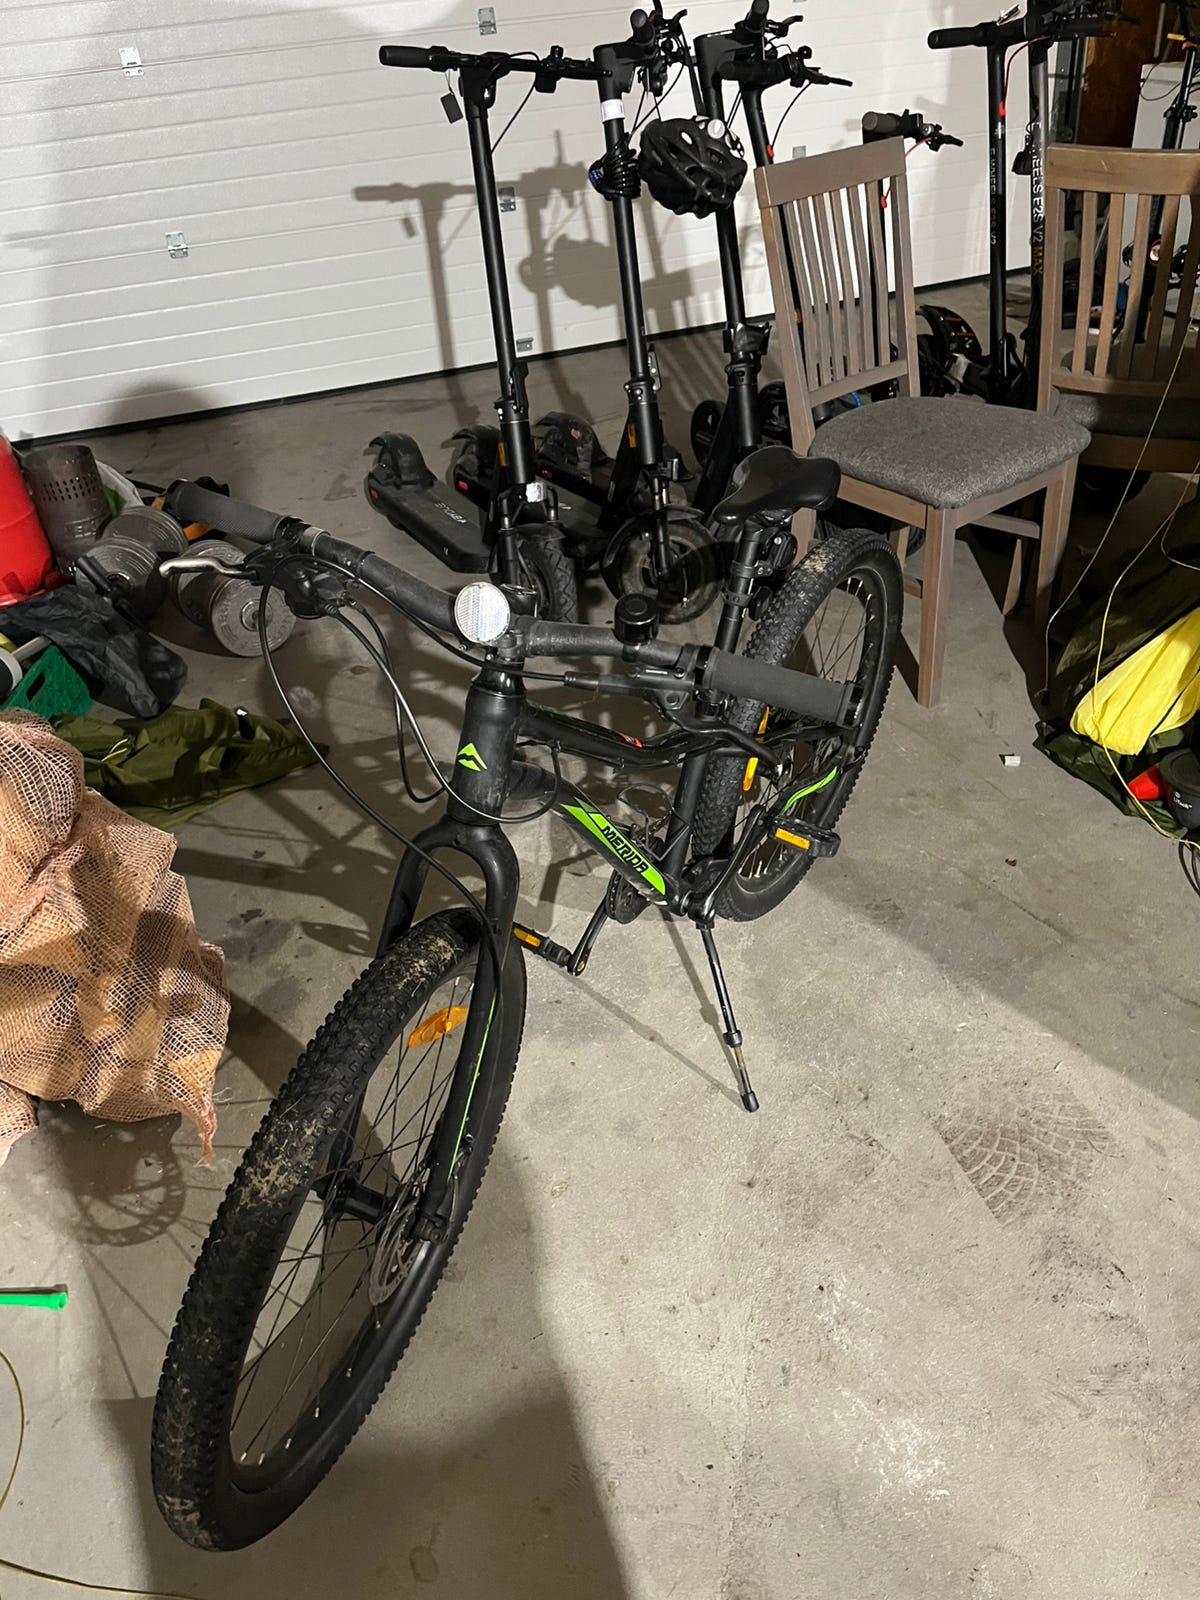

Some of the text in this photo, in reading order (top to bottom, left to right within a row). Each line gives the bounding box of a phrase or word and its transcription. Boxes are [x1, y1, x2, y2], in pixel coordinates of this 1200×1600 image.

[1032, 197, 1043, 222] E2S
[1033, 225, 1043, 243] V2
[1033, 246, 1043, 276] MAX
[602, 825, 649, 873] MERIDA
